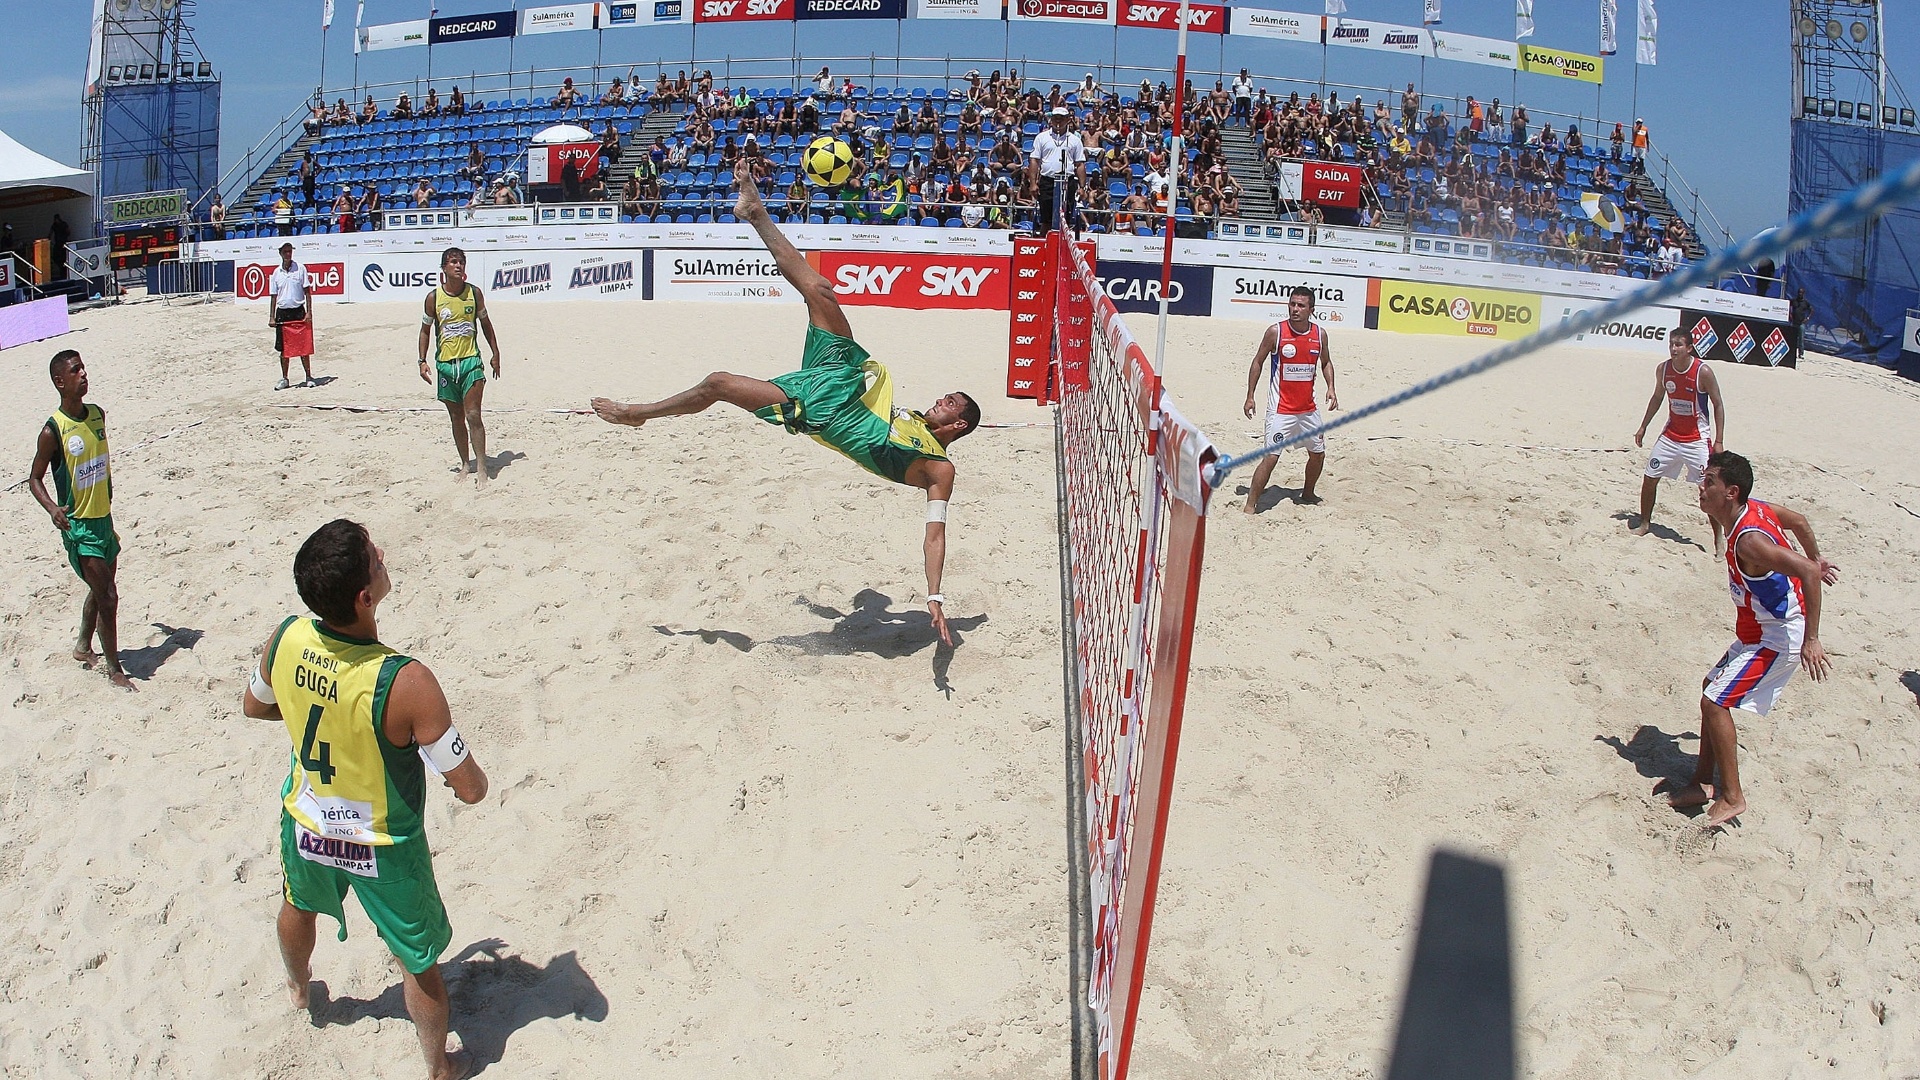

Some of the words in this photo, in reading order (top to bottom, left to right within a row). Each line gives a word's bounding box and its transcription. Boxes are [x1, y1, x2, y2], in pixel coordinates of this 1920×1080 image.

[667, 5, 680, 13] RIO
[702, 0, 738, 16] SKY
[746, 0, 781, 15] SKY
[807, 0, 881, 11] REDECARD
[1046, 2, 1104, 16] piraquê
[532, 10, 575, 21] SulAmérica
[1126, 5, 1167, 22] SKY
[1250, 14, 1300, 26] SulAmérica
[439, 20, 497, 37] REDECARD
[1332, 26, 1370, 38] AZULIM
[1382, 34, 1419, 44] AZULIM
[1524, 52, 1595, 72] CASA&VIDEO
[1314, 168, 1350, 182] SAÍDA
[1318, 189, 1345, 201] EXIT
[116, 197, 177, 218] REDECARD
[1019, 246, 1040, 255] SKY
[1375, 240, 1397, 248] BRASIL
[502, 259, 524, 267] PRODUTOS
[581, 256, 604, 265] PRODUTOS
[674, 258, 782, 277] SulAmérica
[1018, 268, 1038, 278] SKY
[491, 261, 551, 291] AZULIM
[568, 259, 634, 290] AZULIM
[832, 264, 906, 295] SKY
[918, 265, 994, 297] SKY
[520, 282, 552, 295] LIMPA+
[600, 281, 633, 294] LIMPA+
[742, 287, 765, 298] ING
[1235, 278, 1346, 302] SulAmrica
[1017, 291, 1037, 300] SKY
[1389, 294, 1532, 325] CASA&VIDEO
[1016, 313, 1036, 322] SKY
[1015, 335, 1035, 345] SKY
[1014, 358, 1033, 367] SKY
[1013, 380, 1032, 389] SKY
[302, 648, 339, 675] BRASIL
[295, 664, 338, 704] GUGA
[300, 703, 336, 785] 4
[335, 828, 353, 836] ING
[299, 831, 373, 861] AZULIM
[335, 858, 373, 871] LIMPA+
